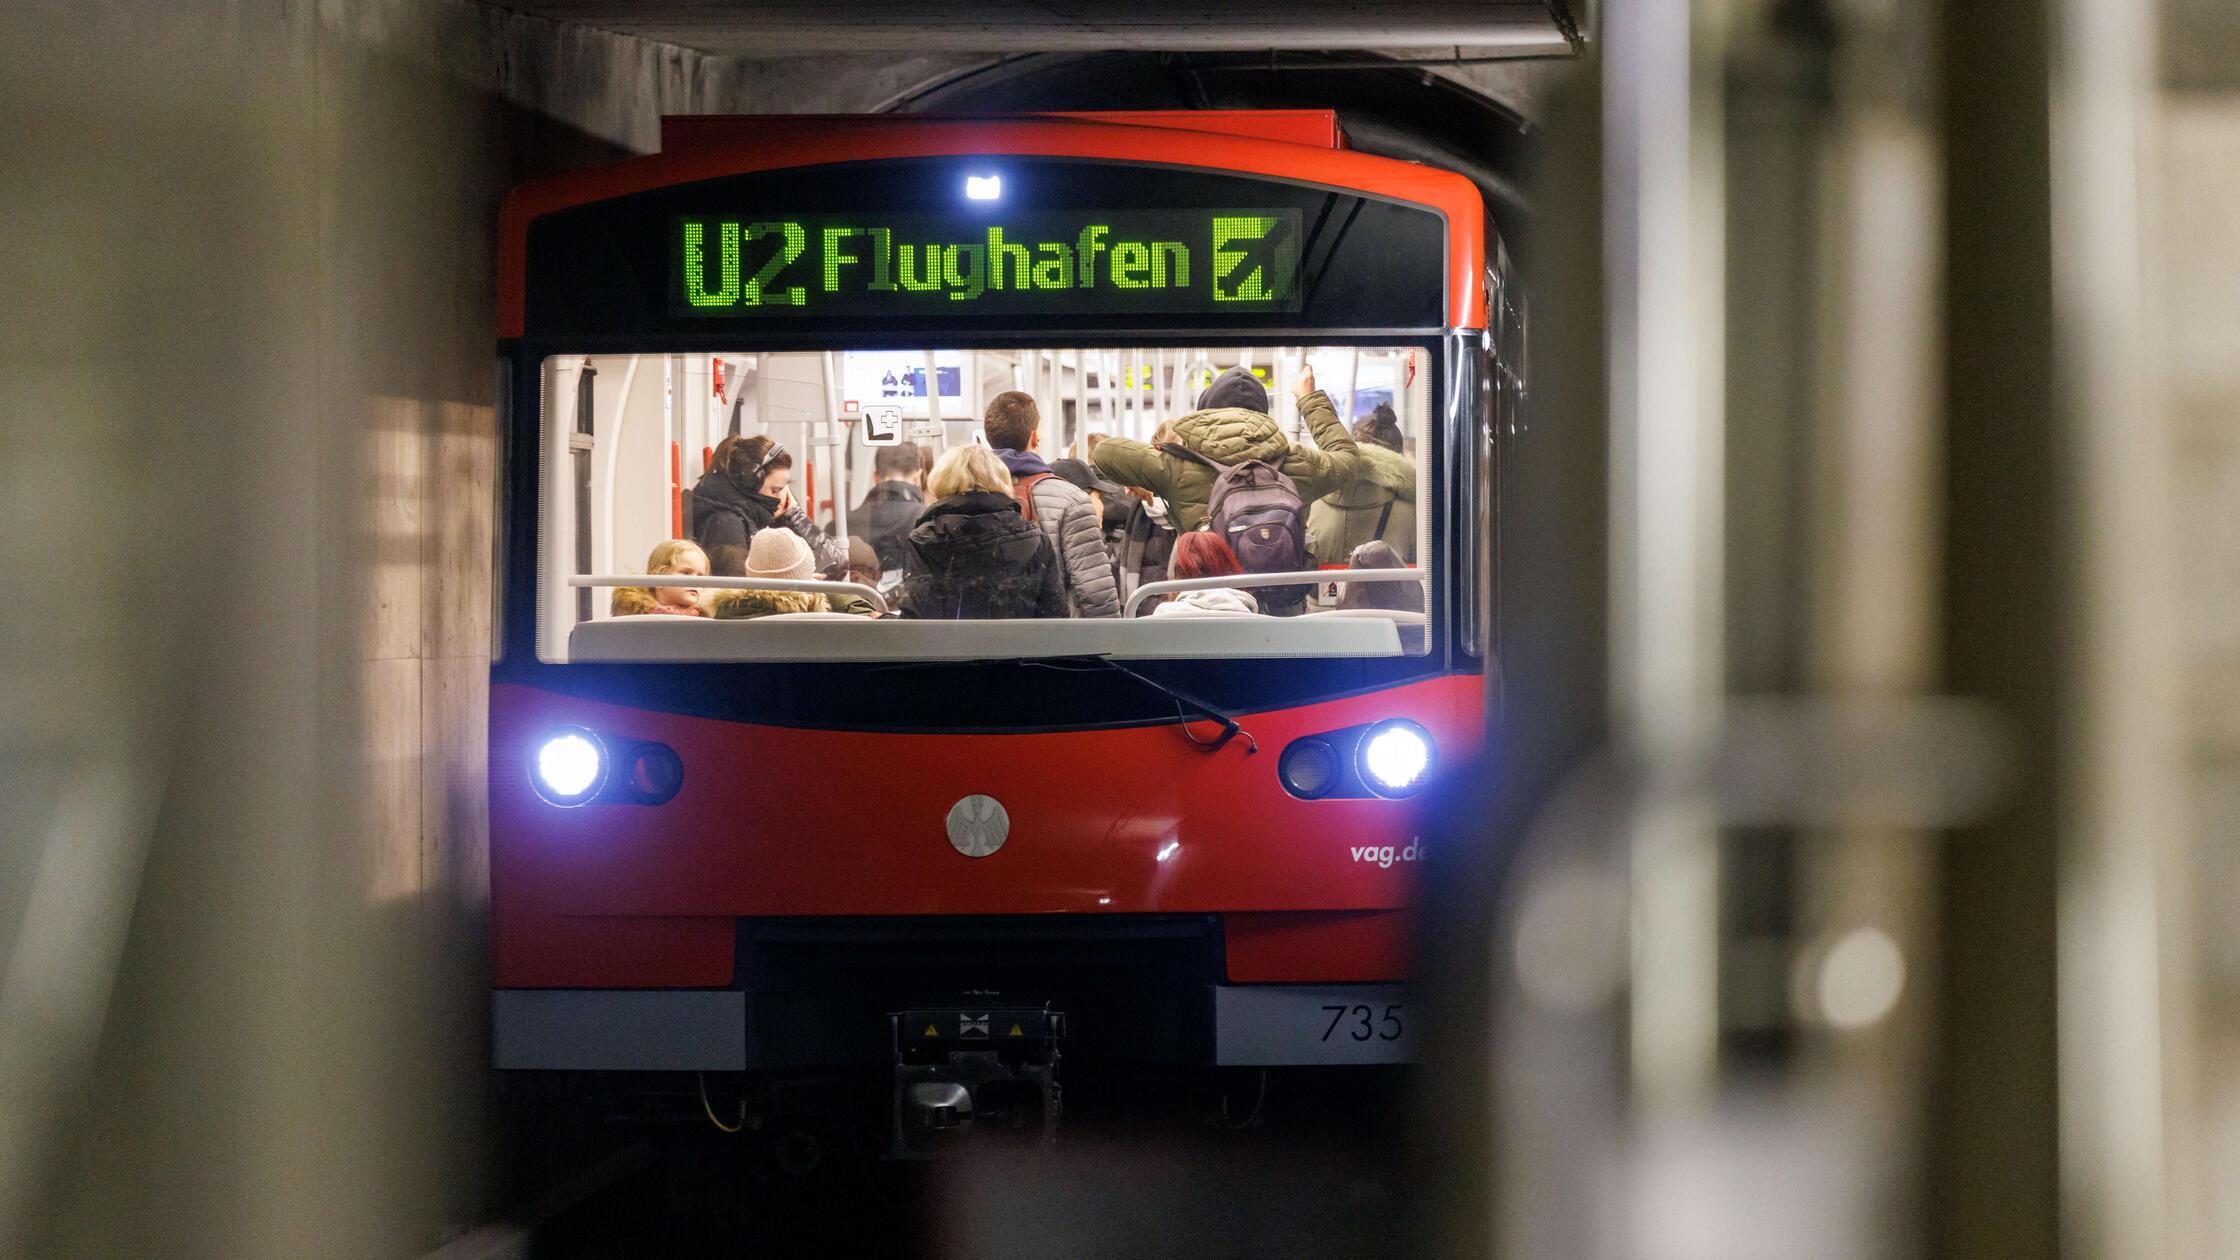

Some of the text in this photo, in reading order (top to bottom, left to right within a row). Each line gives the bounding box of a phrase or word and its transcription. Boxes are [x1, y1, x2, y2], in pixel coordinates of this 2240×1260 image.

[684, 222, 1191, 306] U2 Flughafen
[1321, 1005, 1404, 1042] 735
